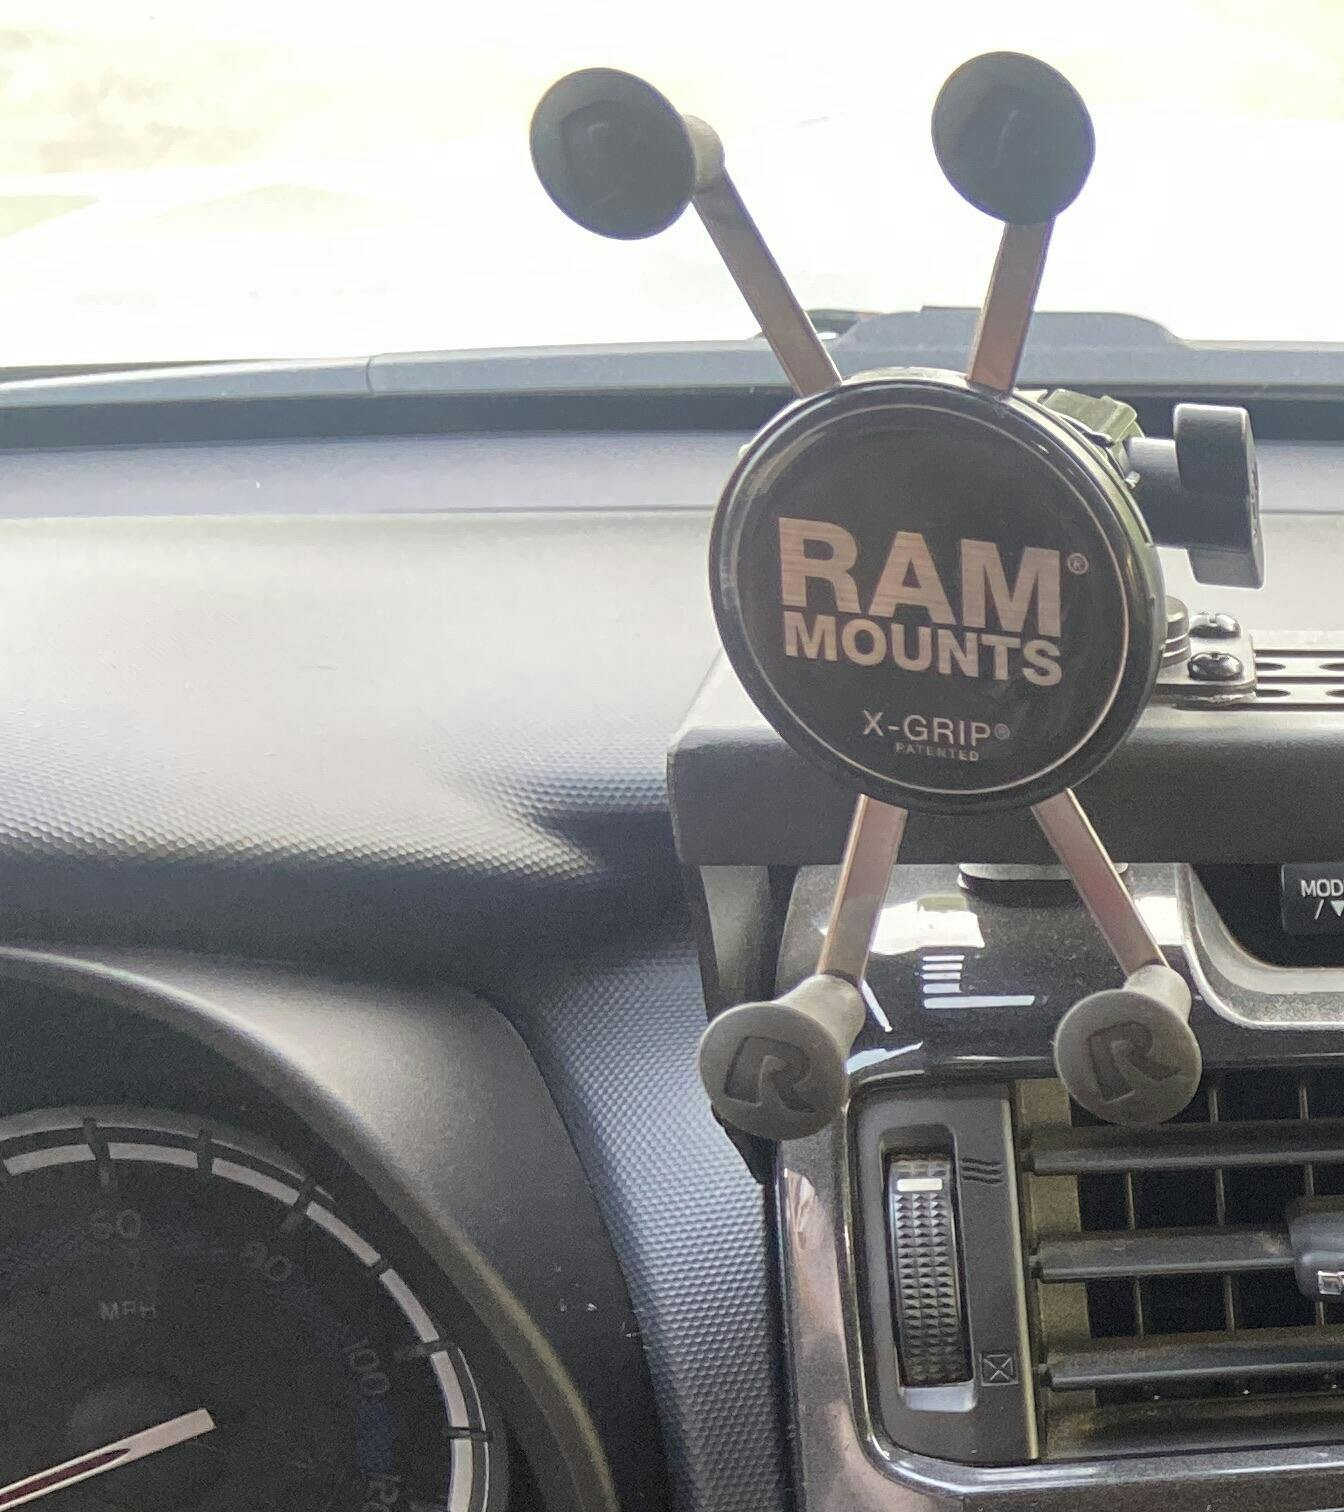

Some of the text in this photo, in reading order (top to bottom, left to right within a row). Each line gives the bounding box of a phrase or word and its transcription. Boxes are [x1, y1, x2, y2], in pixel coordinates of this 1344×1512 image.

[782, 611, 1062, 687] MOUNTS
[895, 741, 980, 762] PATENTED
[343, 1336, 391, 1396] 100
